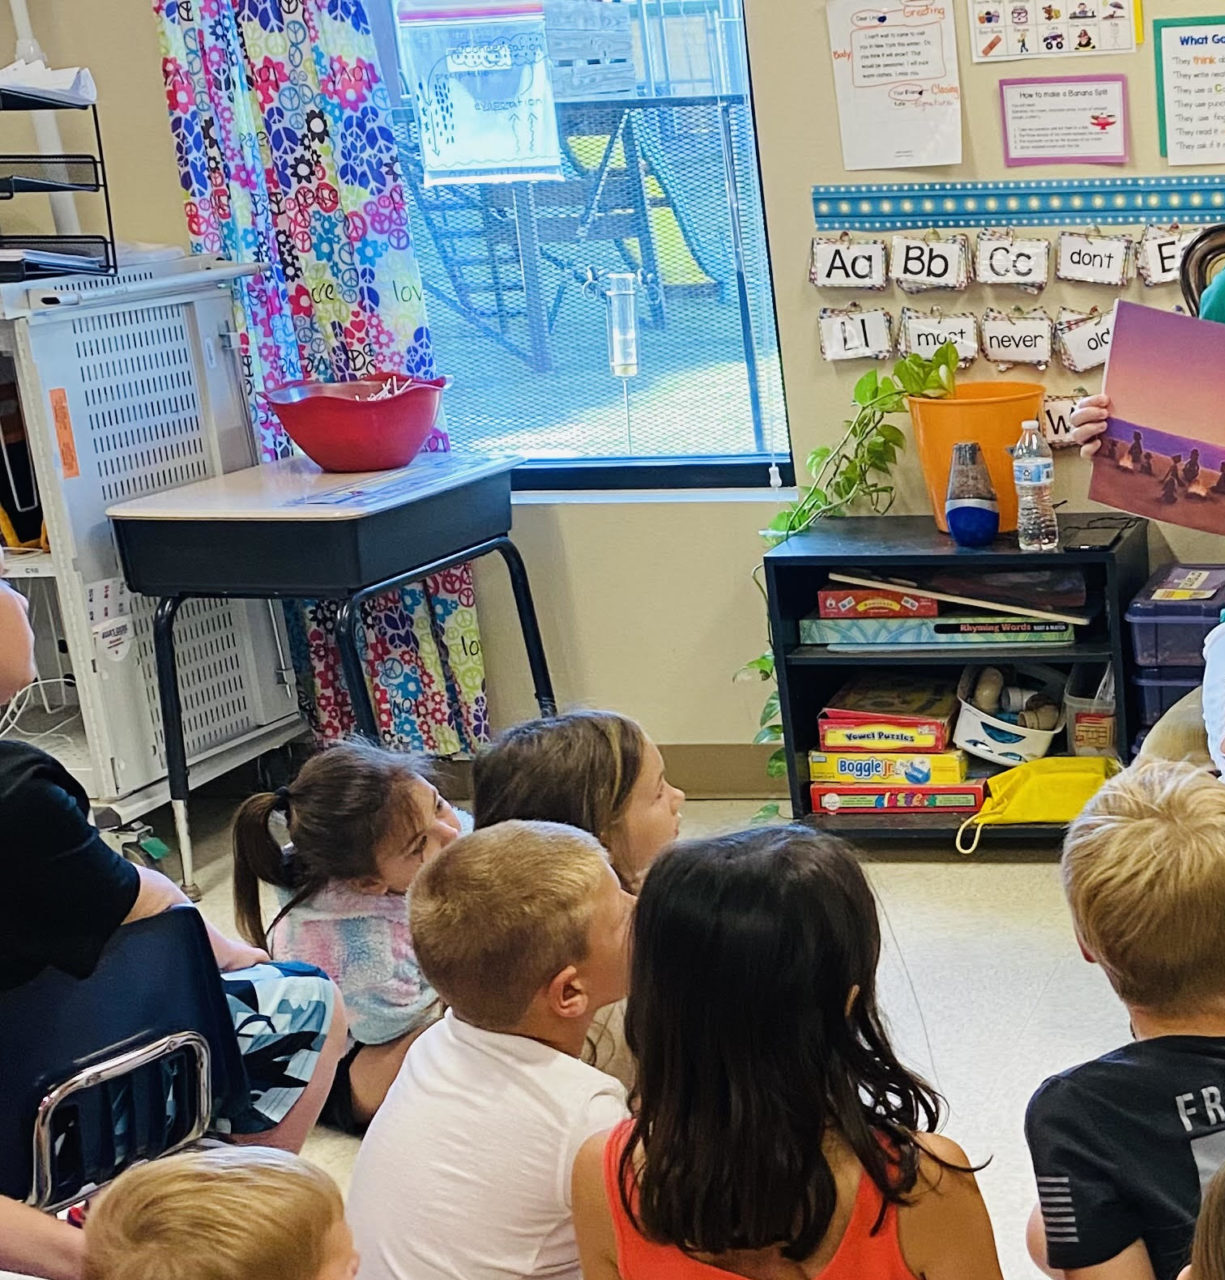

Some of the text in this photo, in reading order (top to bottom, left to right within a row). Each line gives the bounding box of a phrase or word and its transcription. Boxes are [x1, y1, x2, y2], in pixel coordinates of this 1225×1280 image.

[903, 5, 945, 20] Greeting
[1180, 35, 1208, 46] What
[1193, 56, 1216, 64] think
[1020, 90, 1033, 98] How
[1044, 89, 1060, 97] make
[1068, 89, 1093, 97] Banana
[825, 249, 873, 279] Aa
[903, 245, 949, 278] Bb
[989, 247, 1033, 277] Cc
[1158, 241, 1180, 273] E
[841, 319, 869, 351] Ll
[989, 334, 1044, 349] never
[960, 623, 1000, 632] Rhyming
[1001, 623, 1031, 631] Words
[845, 731, 915, 742] Vowel Puzzles
[839, 759, 881, 778] Boggle
